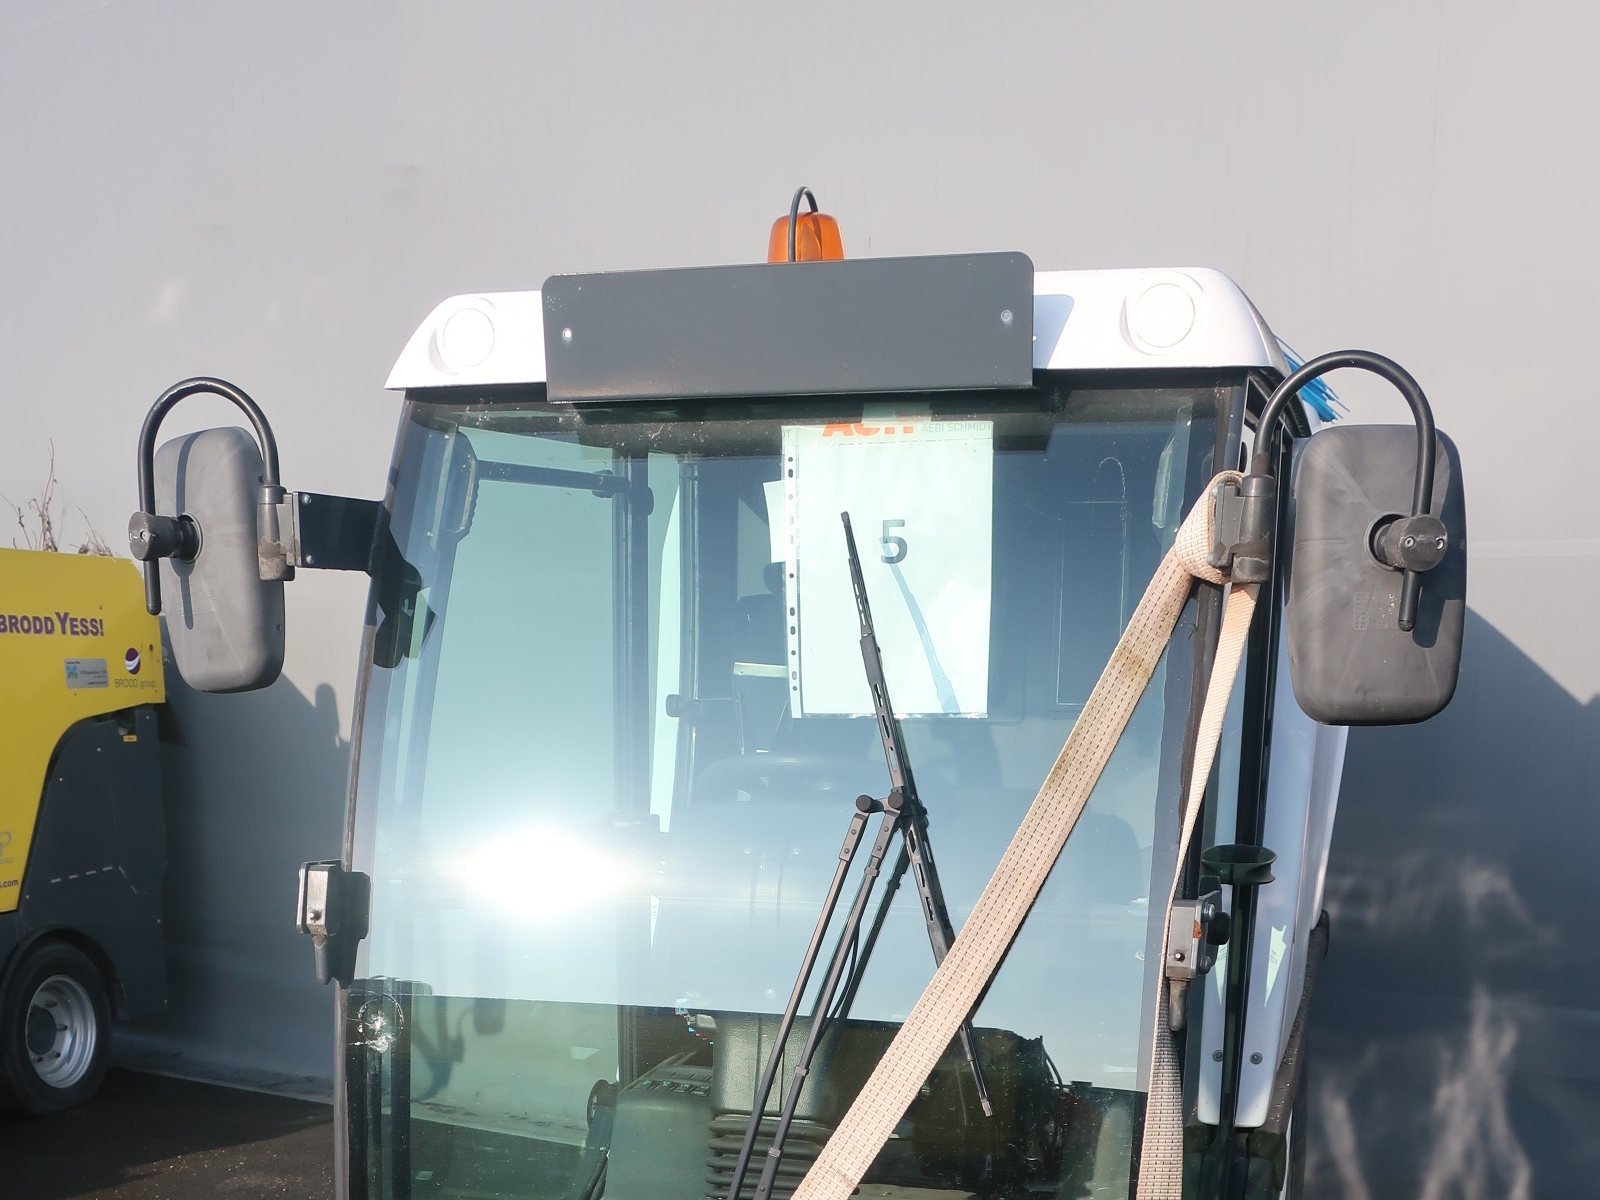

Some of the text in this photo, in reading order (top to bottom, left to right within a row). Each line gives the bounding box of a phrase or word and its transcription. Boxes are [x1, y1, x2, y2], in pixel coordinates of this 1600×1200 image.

[921, 422, 944, 433] AEBI
[947, 421, 992, 432] SCHMIDT
[880, 519, 908, 564] 5
[114, 678, 138, 688] BRODD
